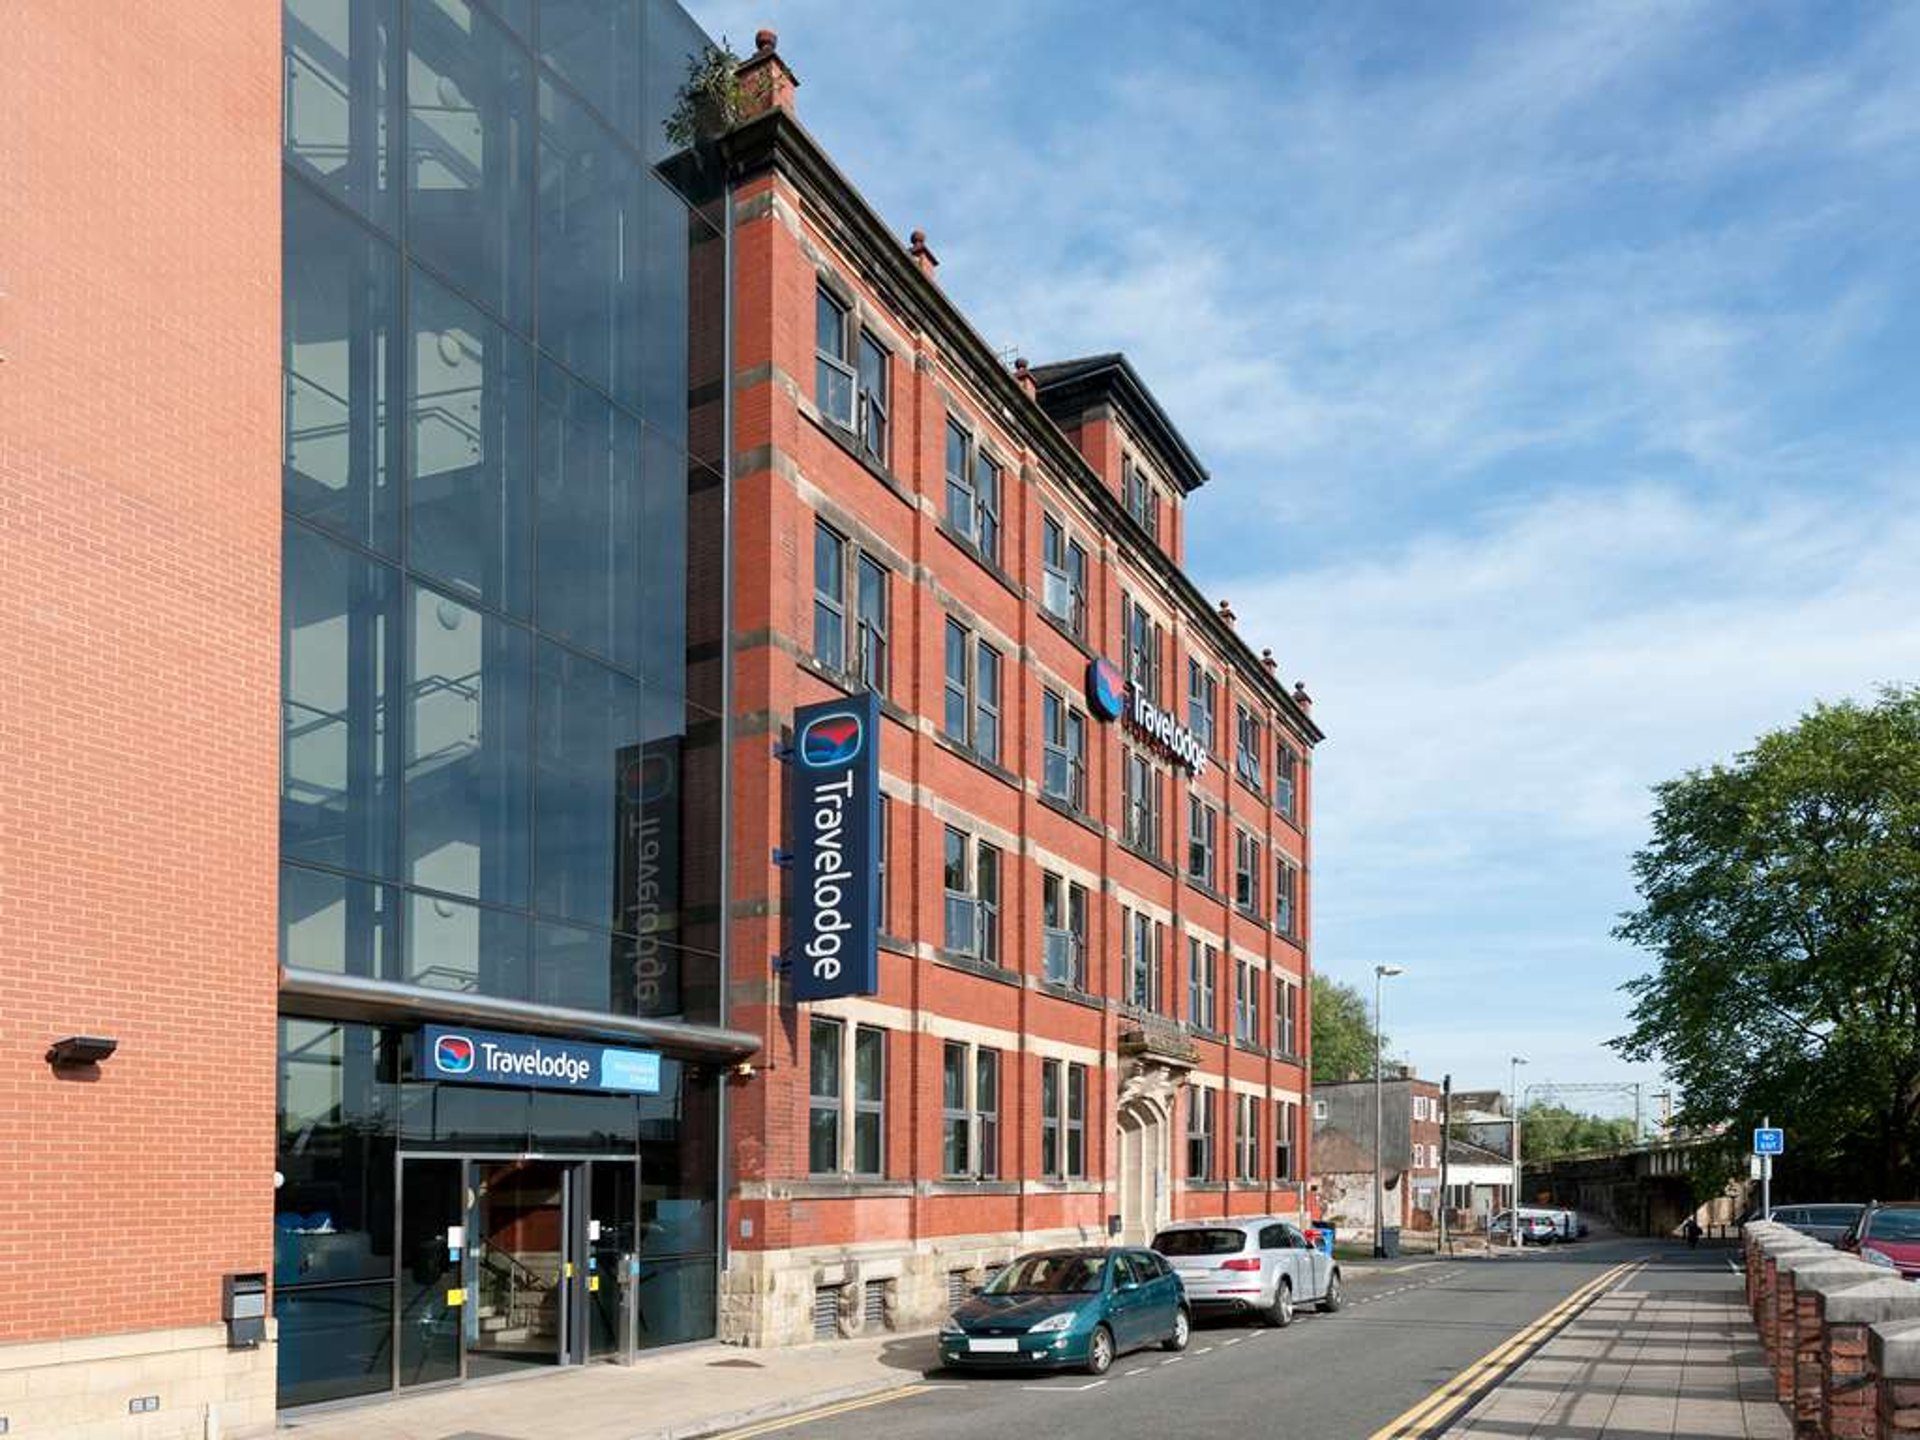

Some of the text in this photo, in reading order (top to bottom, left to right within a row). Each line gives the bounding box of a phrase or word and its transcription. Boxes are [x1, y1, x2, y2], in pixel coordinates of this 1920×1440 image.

[1131, 680, 1206, 776] Travelodge
[805, 769, 853, 980] Travelodge
[480, 1043, 590, 1085] Travelodge
